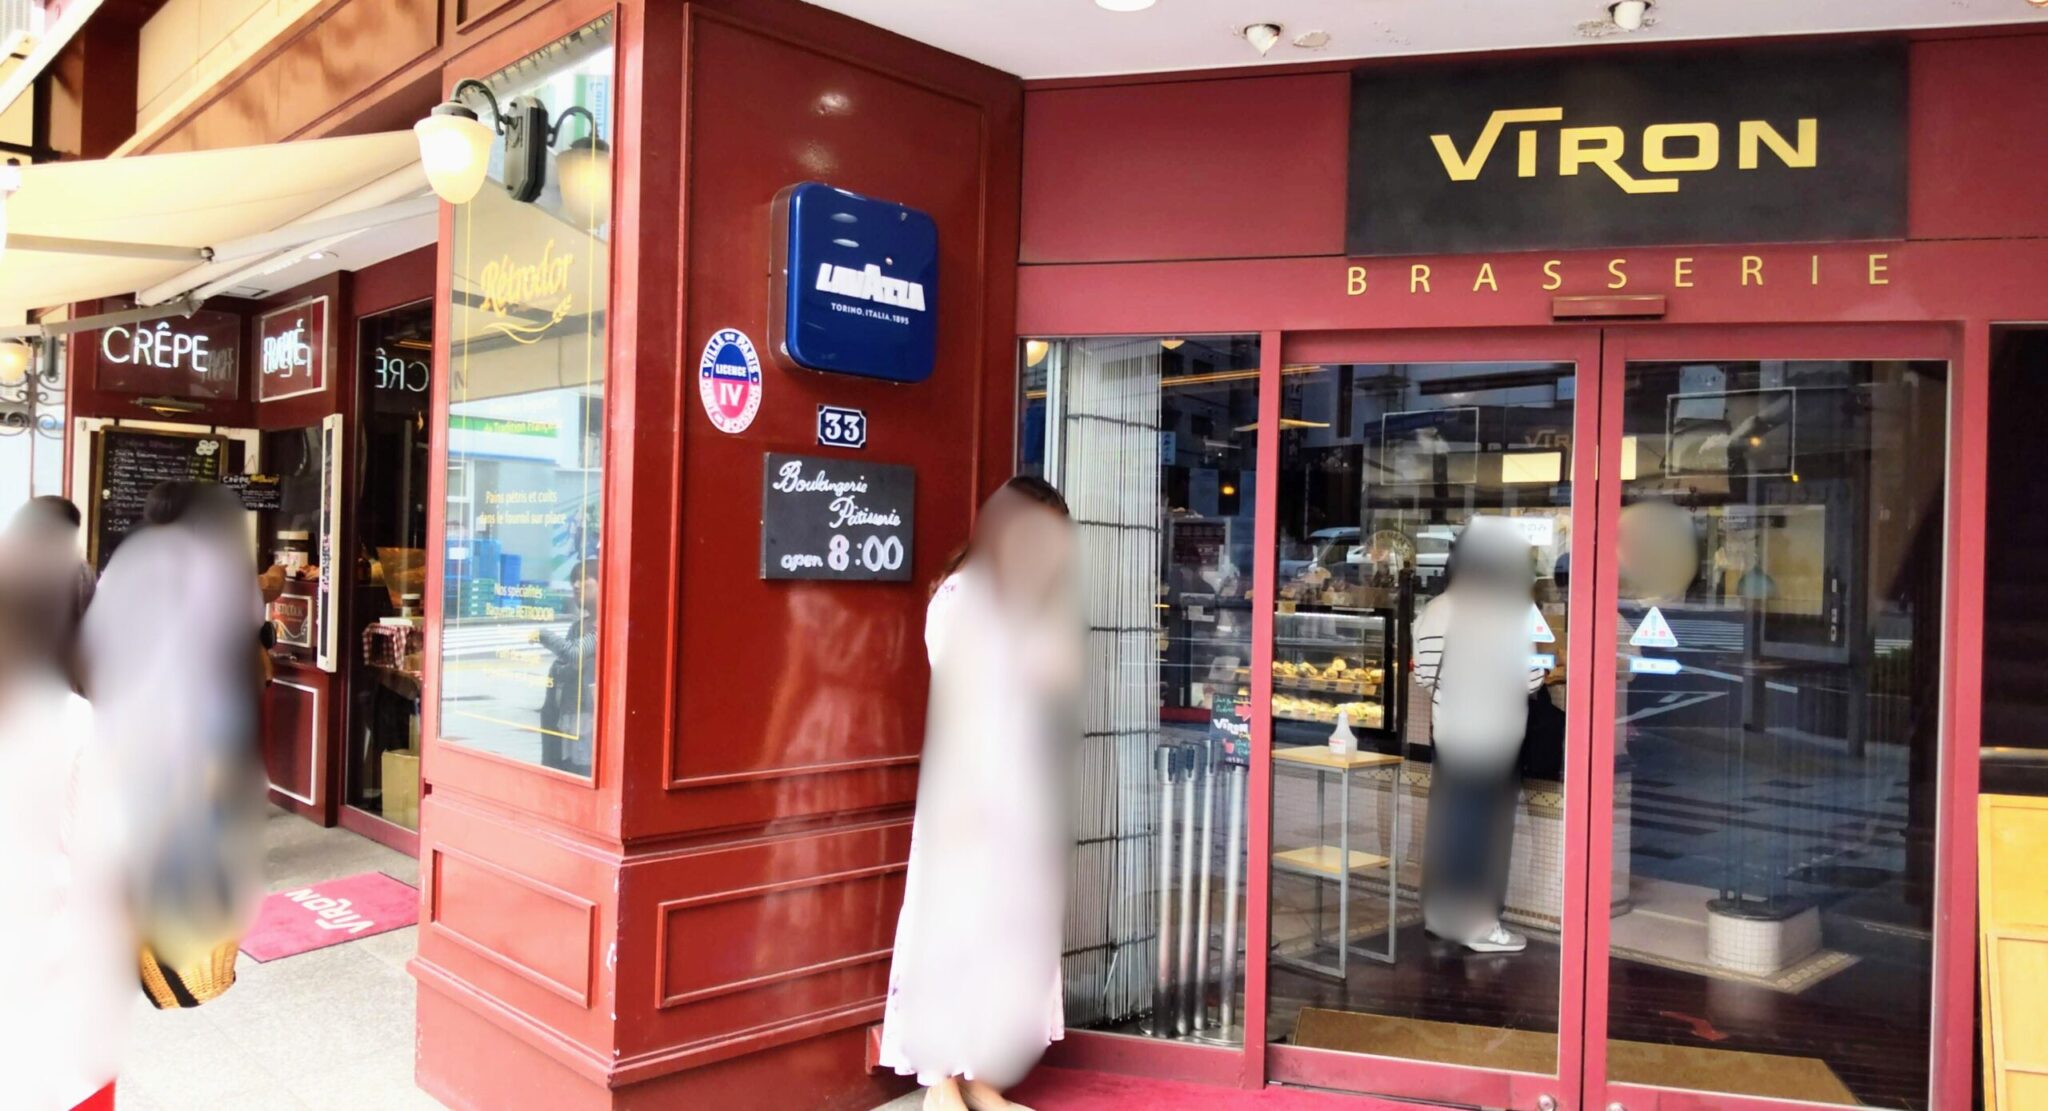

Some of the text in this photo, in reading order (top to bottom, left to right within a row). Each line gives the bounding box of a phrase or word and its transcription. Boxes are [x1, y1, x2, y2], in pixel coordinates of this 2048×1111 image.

[1430, 107, 1817, 194] VIRON
[816, 262, 926, 312] LAVAZZA
[1347, 254, 1889, 295] BRASSERIE
[102, 321, 209, 373] CRÊPE
[714, 363, 748, 377] LICENCE
[719, 381, 744, 407] IV
[825, 412, 861, 442] 33
[773, 460, 868, 497] Boulangerie
[780, 554, 823, 572] open
[284, 888, 374, 934] VIRON
